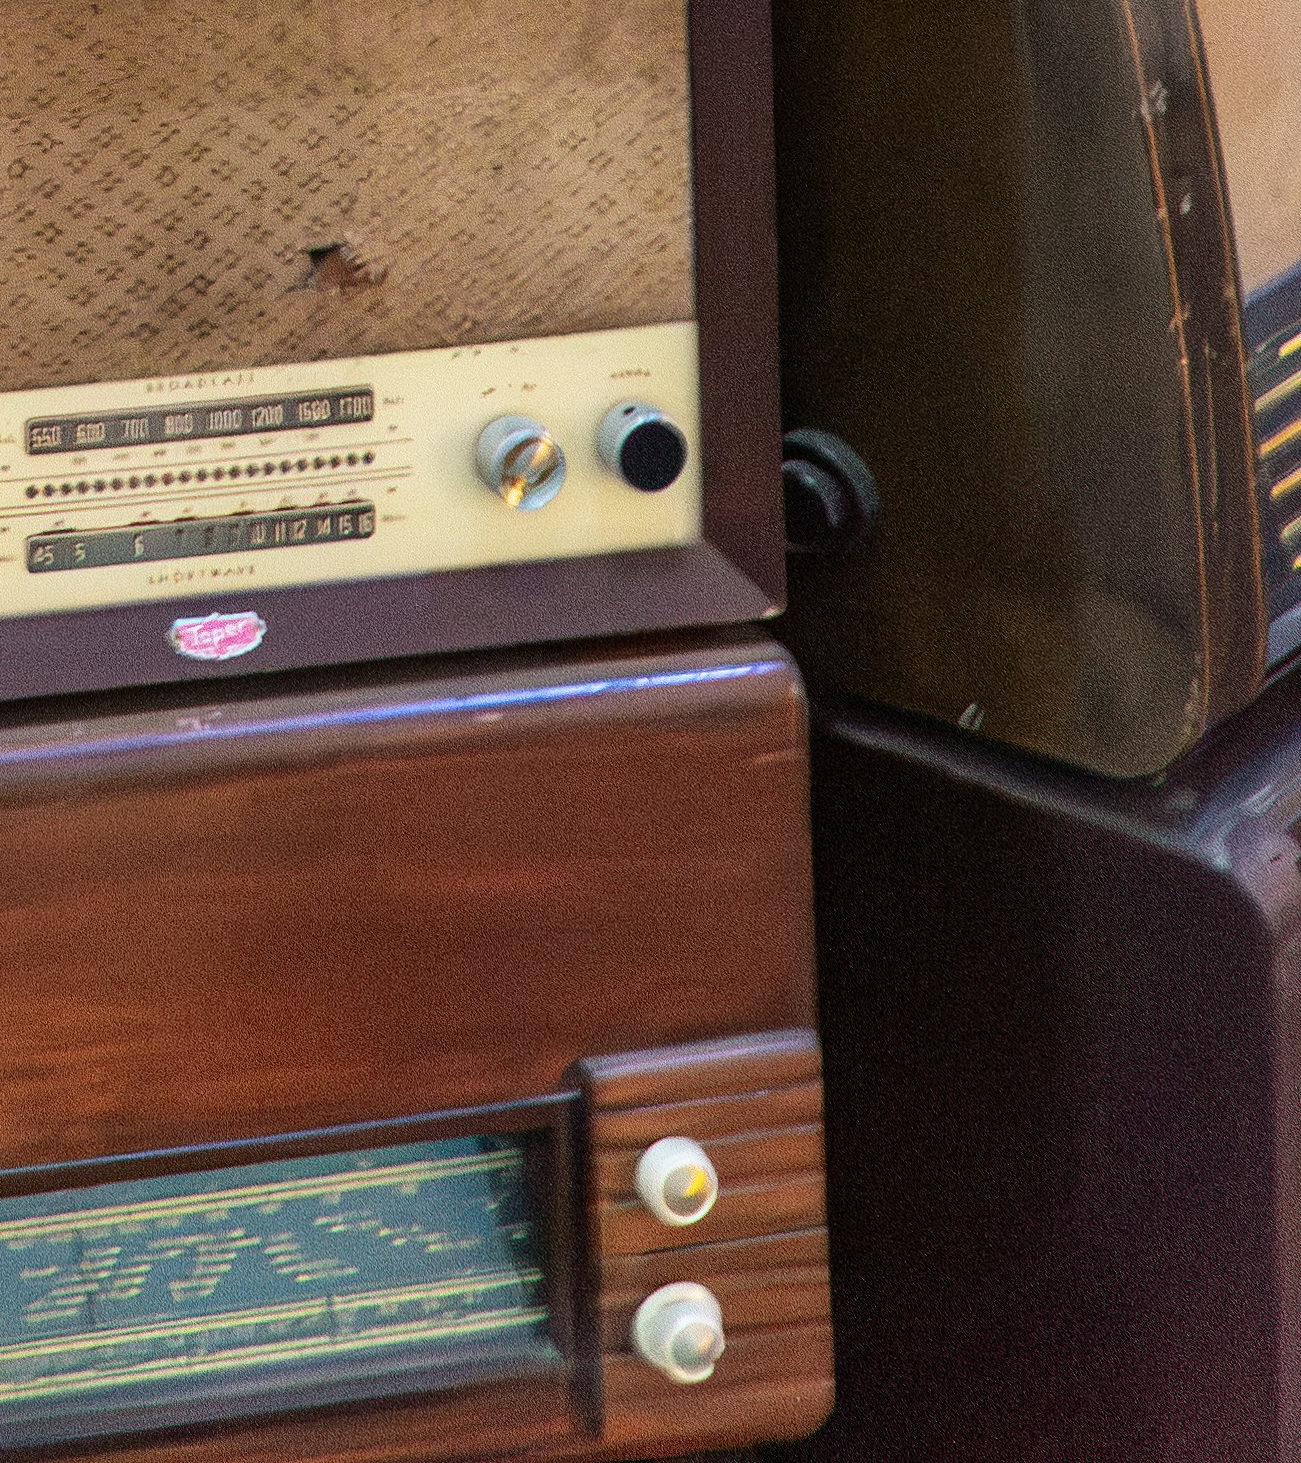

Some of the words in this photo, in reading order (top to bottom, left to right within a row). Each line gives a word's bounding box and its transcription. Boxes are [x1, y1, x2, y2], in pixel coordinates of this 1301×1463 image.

[31, 426, 62, 447] 550
[122, 417, 149, 439] 700
[164, 413, 193, 435] 800
[208, 408, 242, 431] 1000
